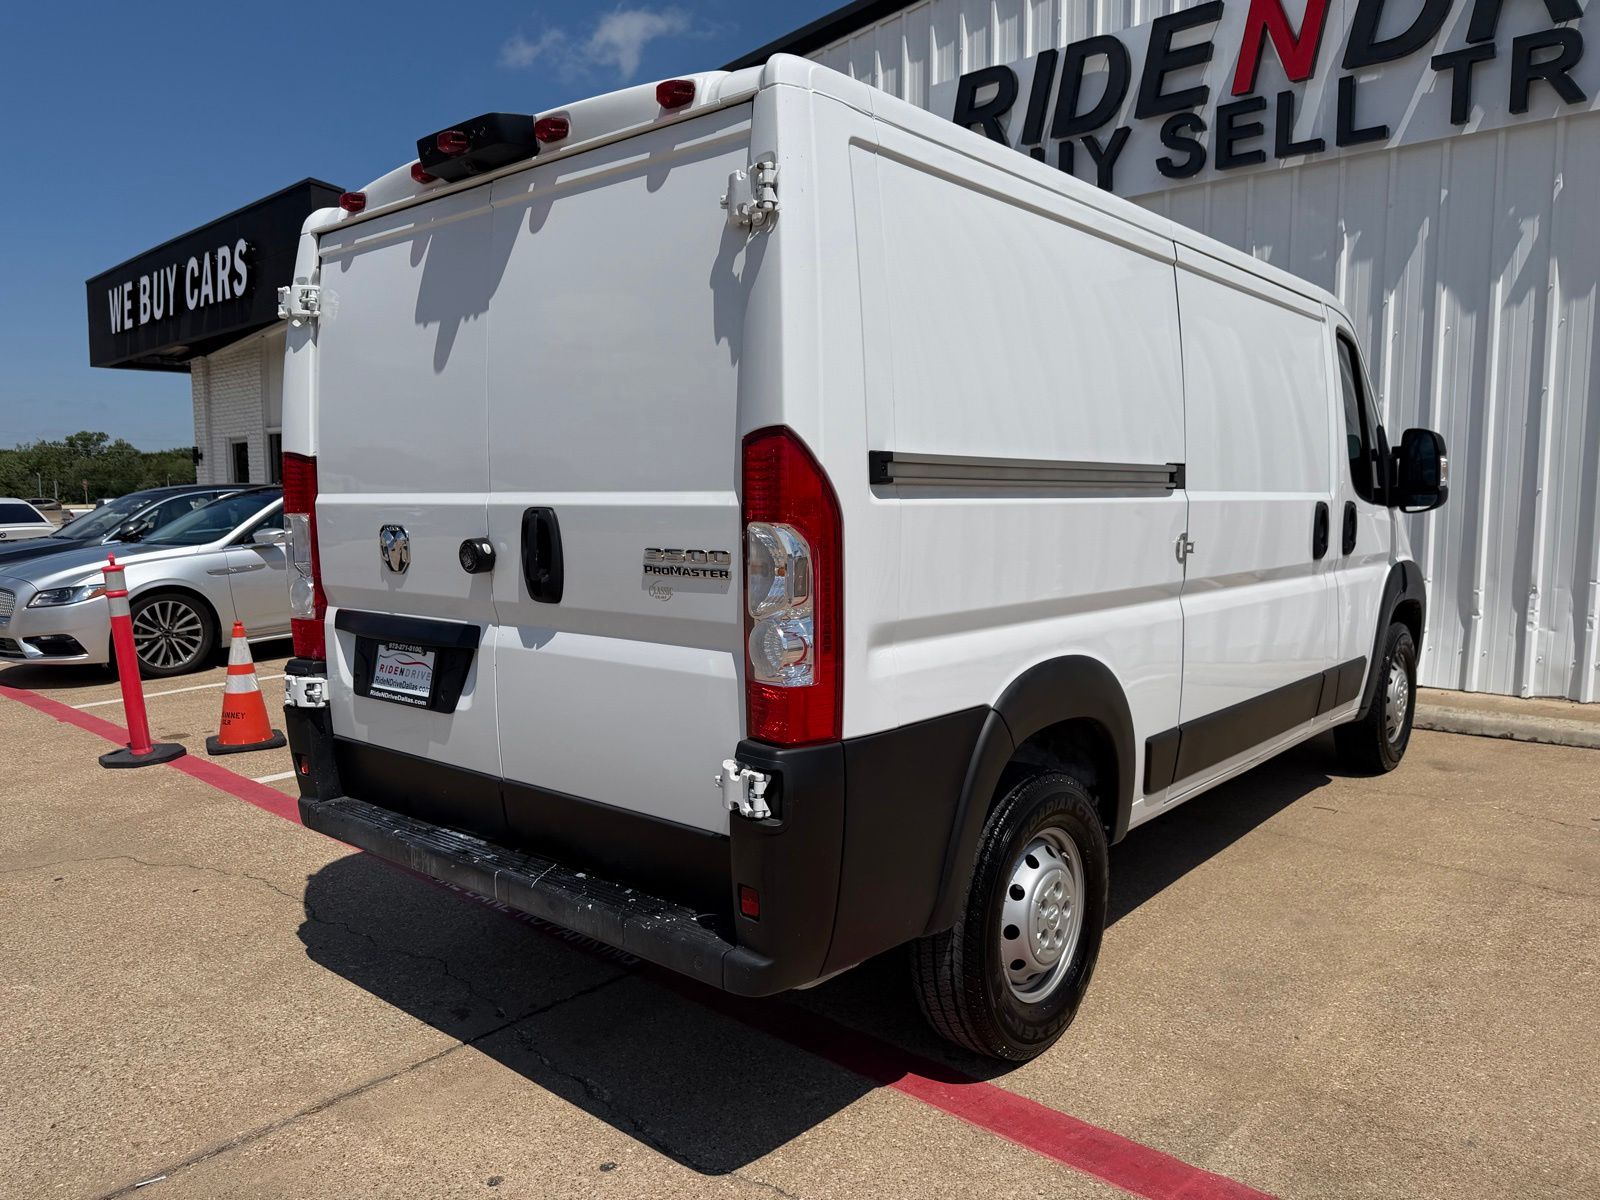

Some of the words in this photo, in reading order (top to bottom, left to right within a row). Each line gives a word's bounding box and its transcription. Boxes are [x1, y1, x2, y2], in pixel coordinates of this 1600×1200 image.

[1155, 75, 1390, 178] SELL
[108, 281, 133, 334] WE
[138, 263, 177, 325] BUY
[185, 238, 248, 310] CARS
[379, 663, 432, 682] RIDENDRIVE
